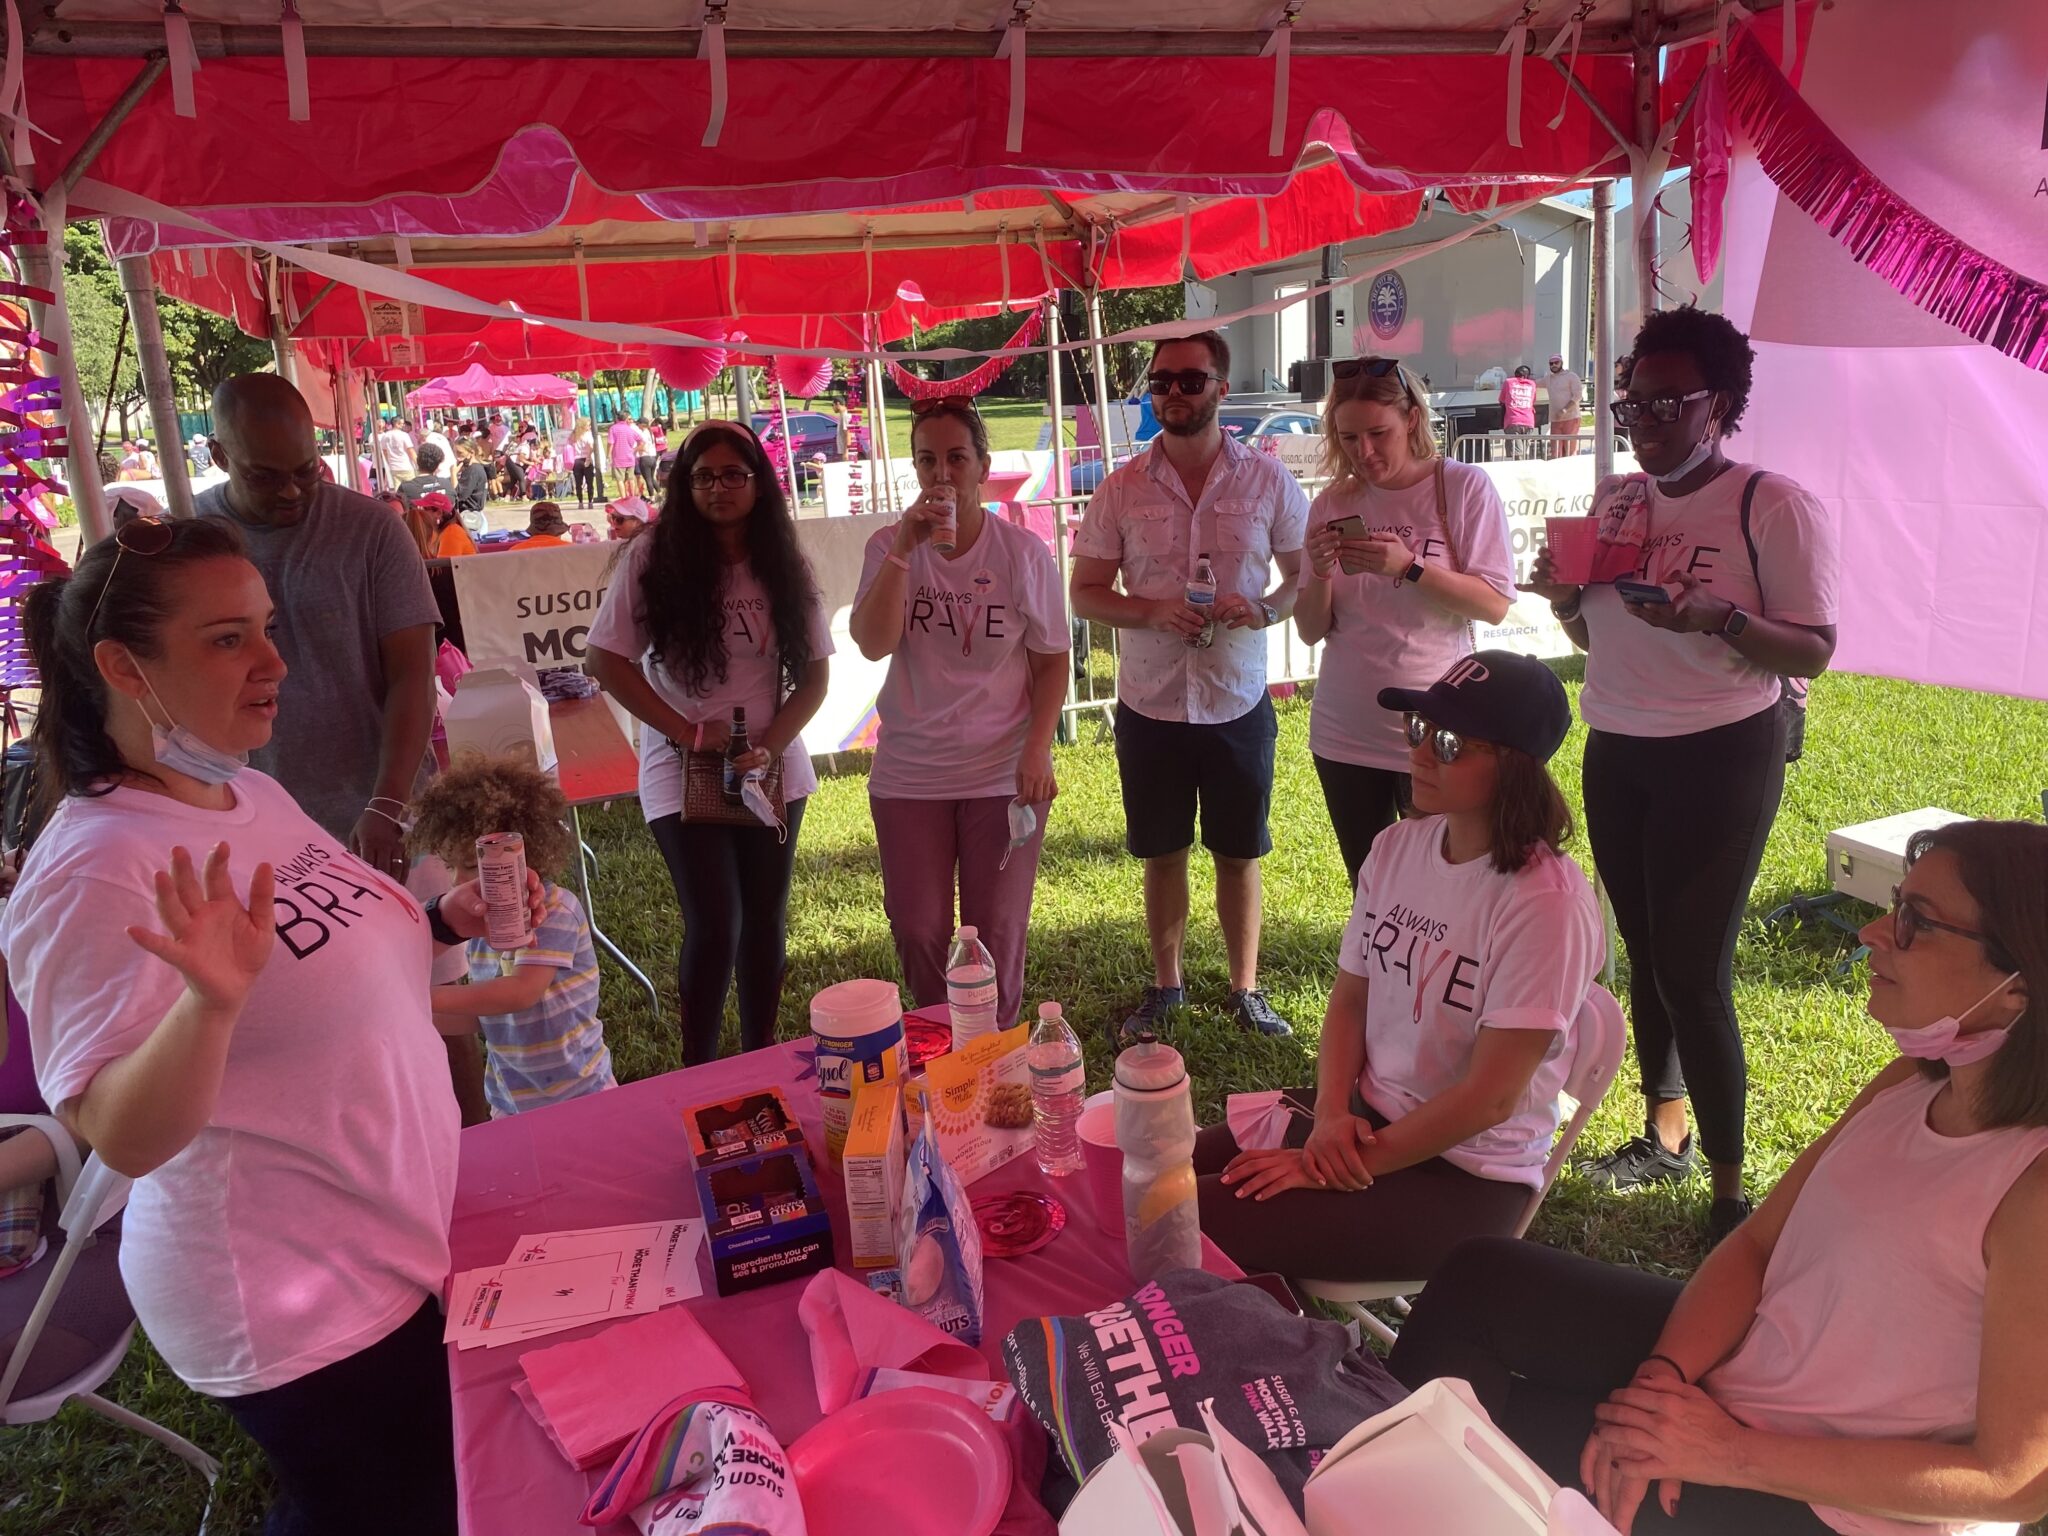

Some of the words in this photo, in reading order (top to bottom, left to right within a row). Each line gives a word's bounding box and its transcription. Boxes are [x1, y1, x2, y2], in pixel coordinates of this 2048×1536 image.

[916, 585, 972, 604] ALWAYS
[904, 599, 1006, 656] RAVE
[1483, 625, 1539, 639] RESEARCH
[274, 843, 331, 887] ALWAYS
[1386, 904, 1448, 942] ALWAYS
[945, 1077, 976, 1099] Simple
[632, 1248, 645, 1268] MORE
[732, 1252, 783, 1271] ingredients
[783, 1247, 801, 1260] you
[802, 1242, 820, 1254] can
[733, 1269, 750, 1279] see
[759, 1254, 808, 1273] pronounce
[628, 1267, 641, 1289] THAN
[1076, 1340, 1090, 1360] We
[1083, 1355, 1100, 1382] Will
[1091, 1381, 1110, 1411] End
[1270, 1375, 1295, 1406] susan
[1241, 1383, 1264, 1411] PINK
[1256, 1410, 1280, 1450] WALK
[1254, 1378, 1279, 1410] MORE
[1272, 1408, 1293, 1448] THAN
[732, 1448, 785, 1479] MORE
[730, 1471, 784, 1499] susan
